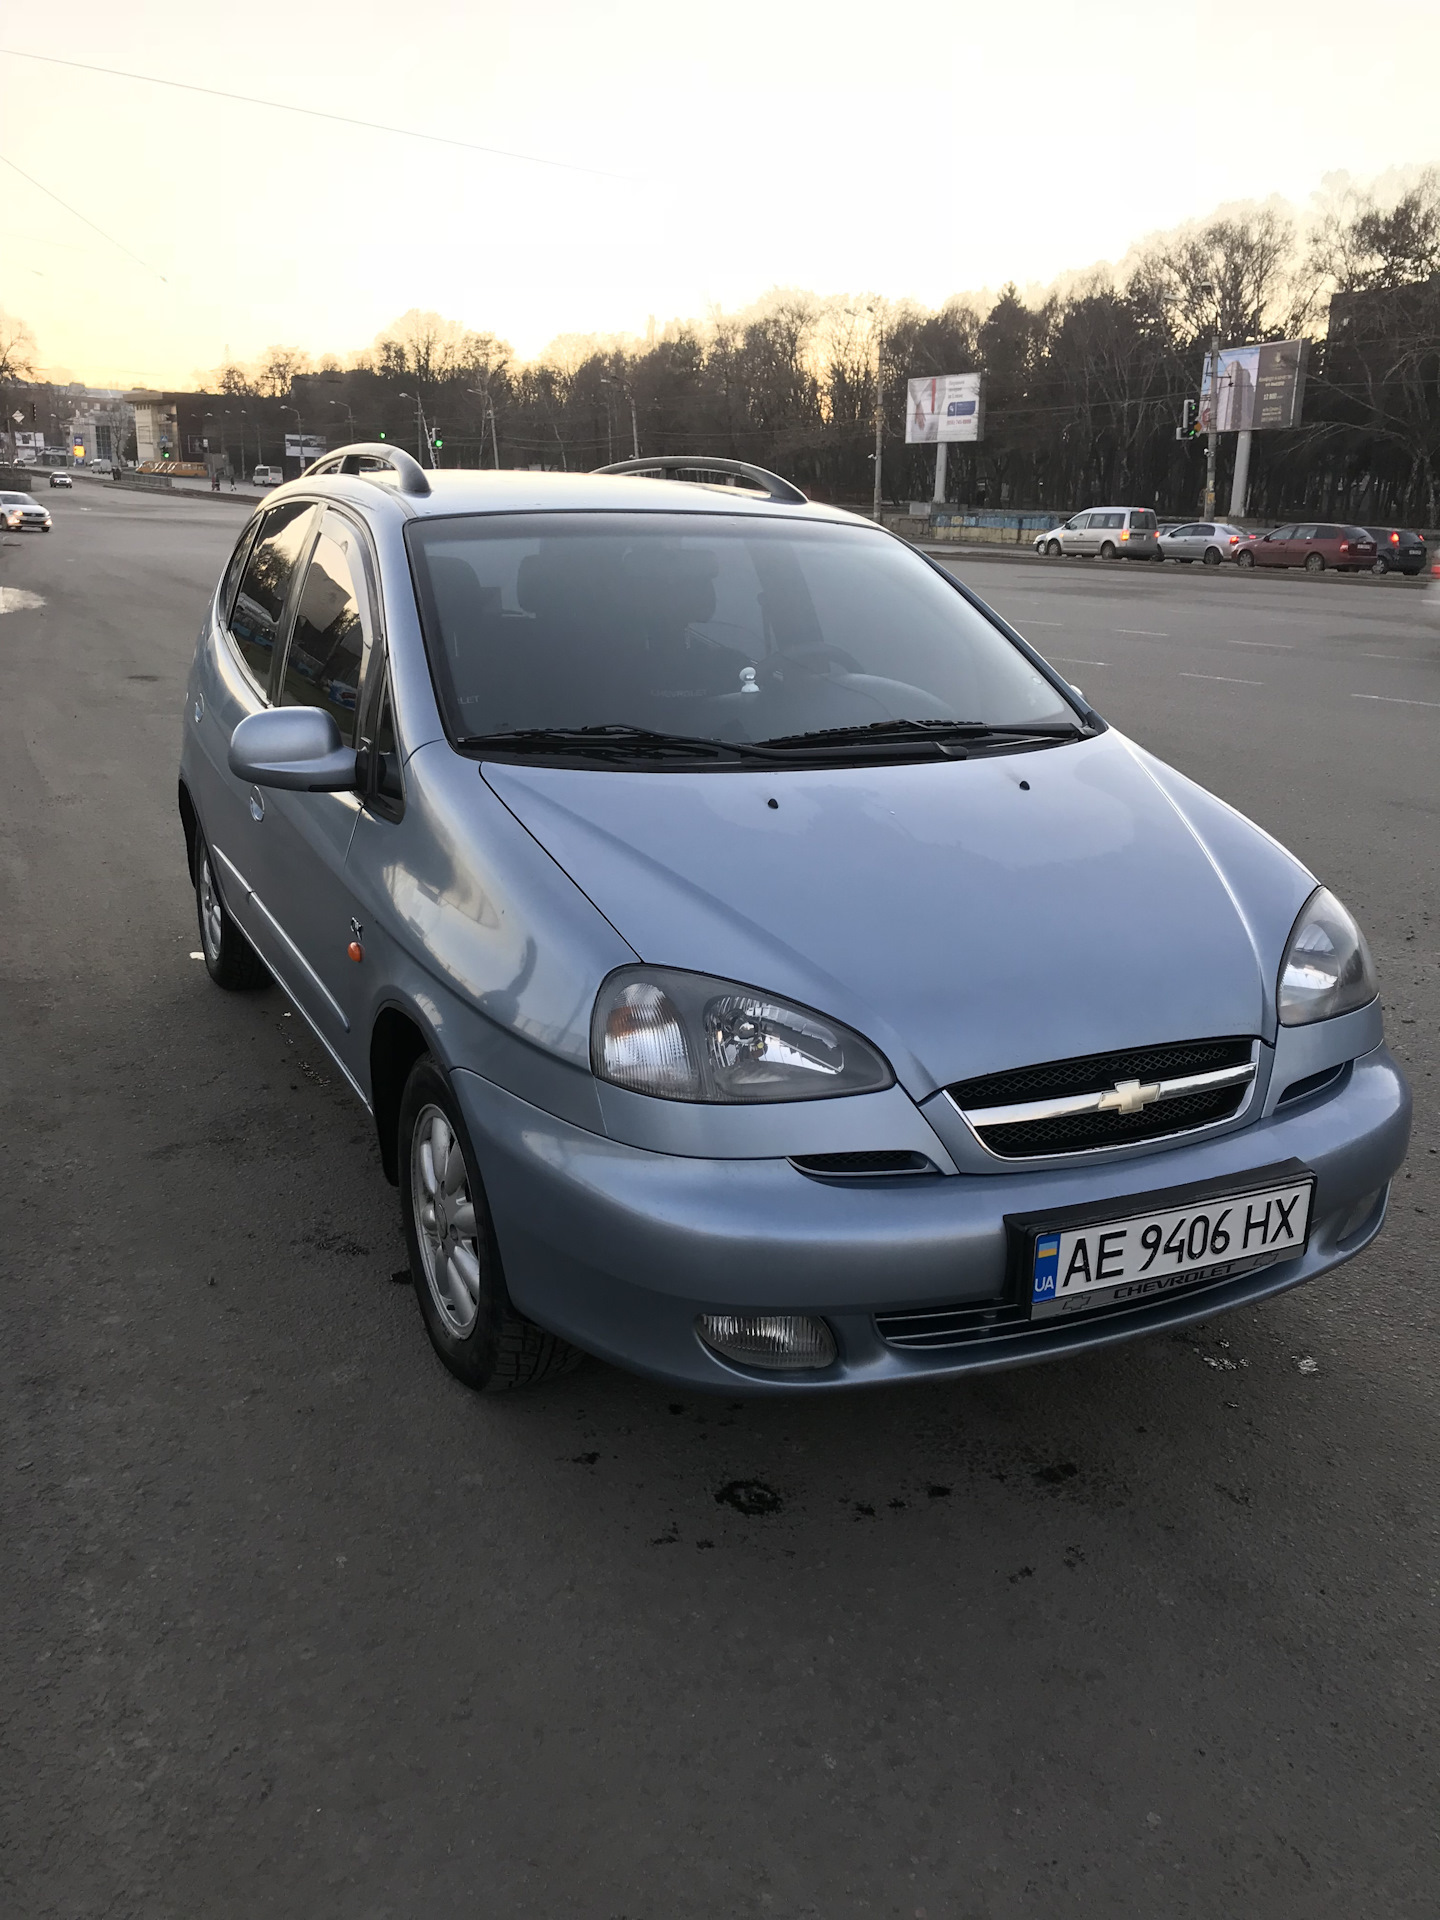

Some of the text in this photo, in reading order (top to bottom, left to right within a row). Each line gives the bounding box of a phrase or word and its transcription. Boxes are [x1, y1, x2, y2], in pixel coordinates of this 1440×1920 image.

[1062, 1194, 1300, 1288] AE 9406 HX
[1034, 1274, 1055, 1293] UA
[1113, 1262, 1236, 1299] CHEVROLET
